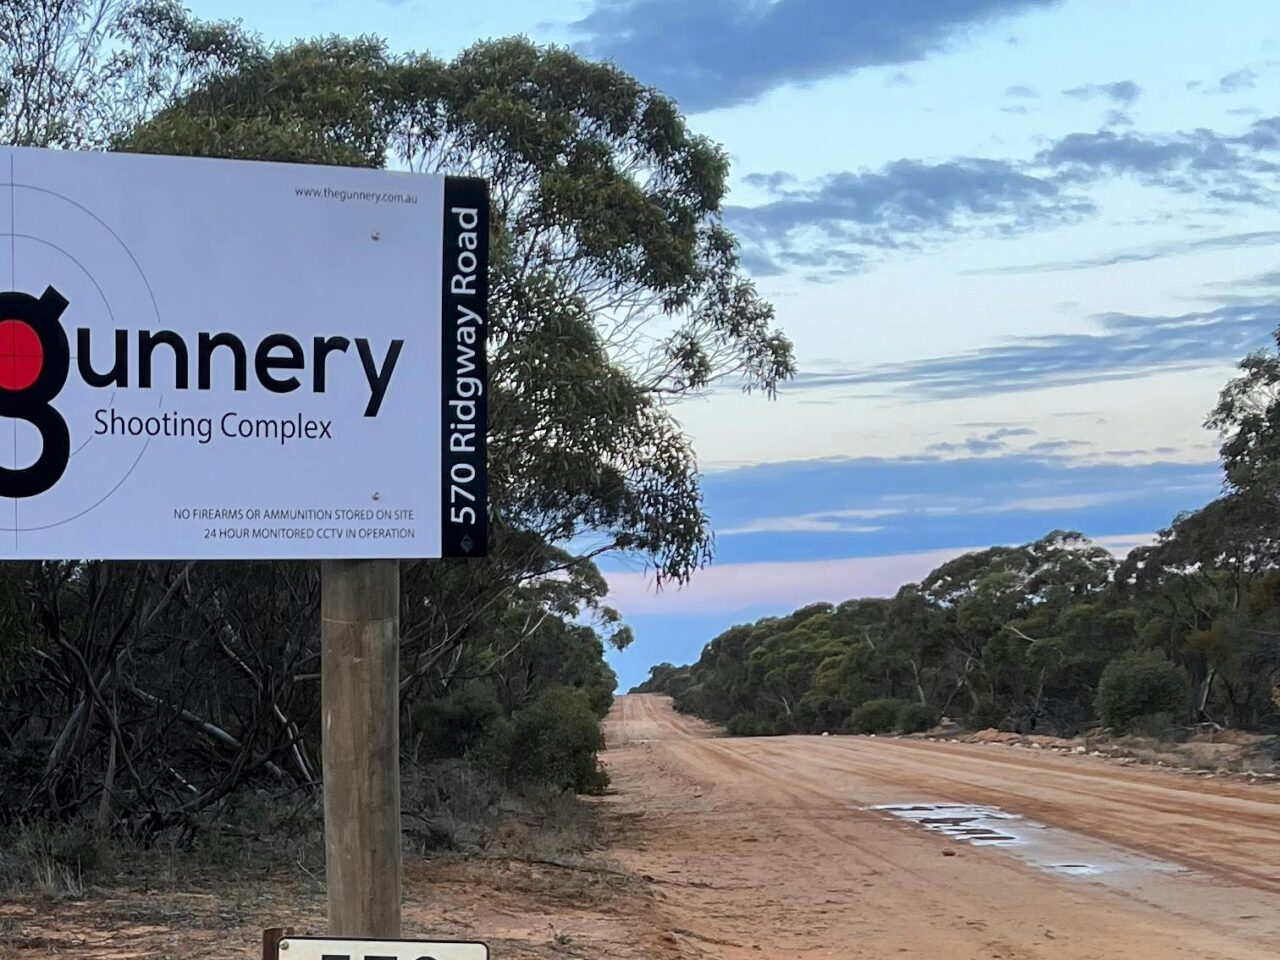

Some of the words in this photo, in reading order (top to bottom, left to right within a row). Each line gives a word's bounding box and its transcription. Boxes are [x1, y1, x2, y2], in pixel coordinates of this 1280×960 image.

[295, 187, 418, 204] www.thegunnery.com.au
[451, 207, 478, 295] Road
[449, 304, 483, 453] Ridgway
[94, 408, 213, 444] Shooting
[220, 412, 332, 445] Complex
[451, 463, 477, 525] 570
[174, 508, 191, 520] NO
[193, 508, 243, 520] FIREARMS
[245, 508, 261, 520] OR
[263, 508, 332, 520] AMMUNITION
[334, 509, 374, 520] STORED
[376, 509, 392, 520] ON
[394, 509, 415, 520] SITE
[204, 528, 217, 539] 24
[219, 528, 250, 539] HOUR
[252, 528, 315, 539] MONITORED
[316, 528, 344, 539] CCTV
[345, 528, 357, 539] IN
[358, 528, 416, 539] OPERATION
